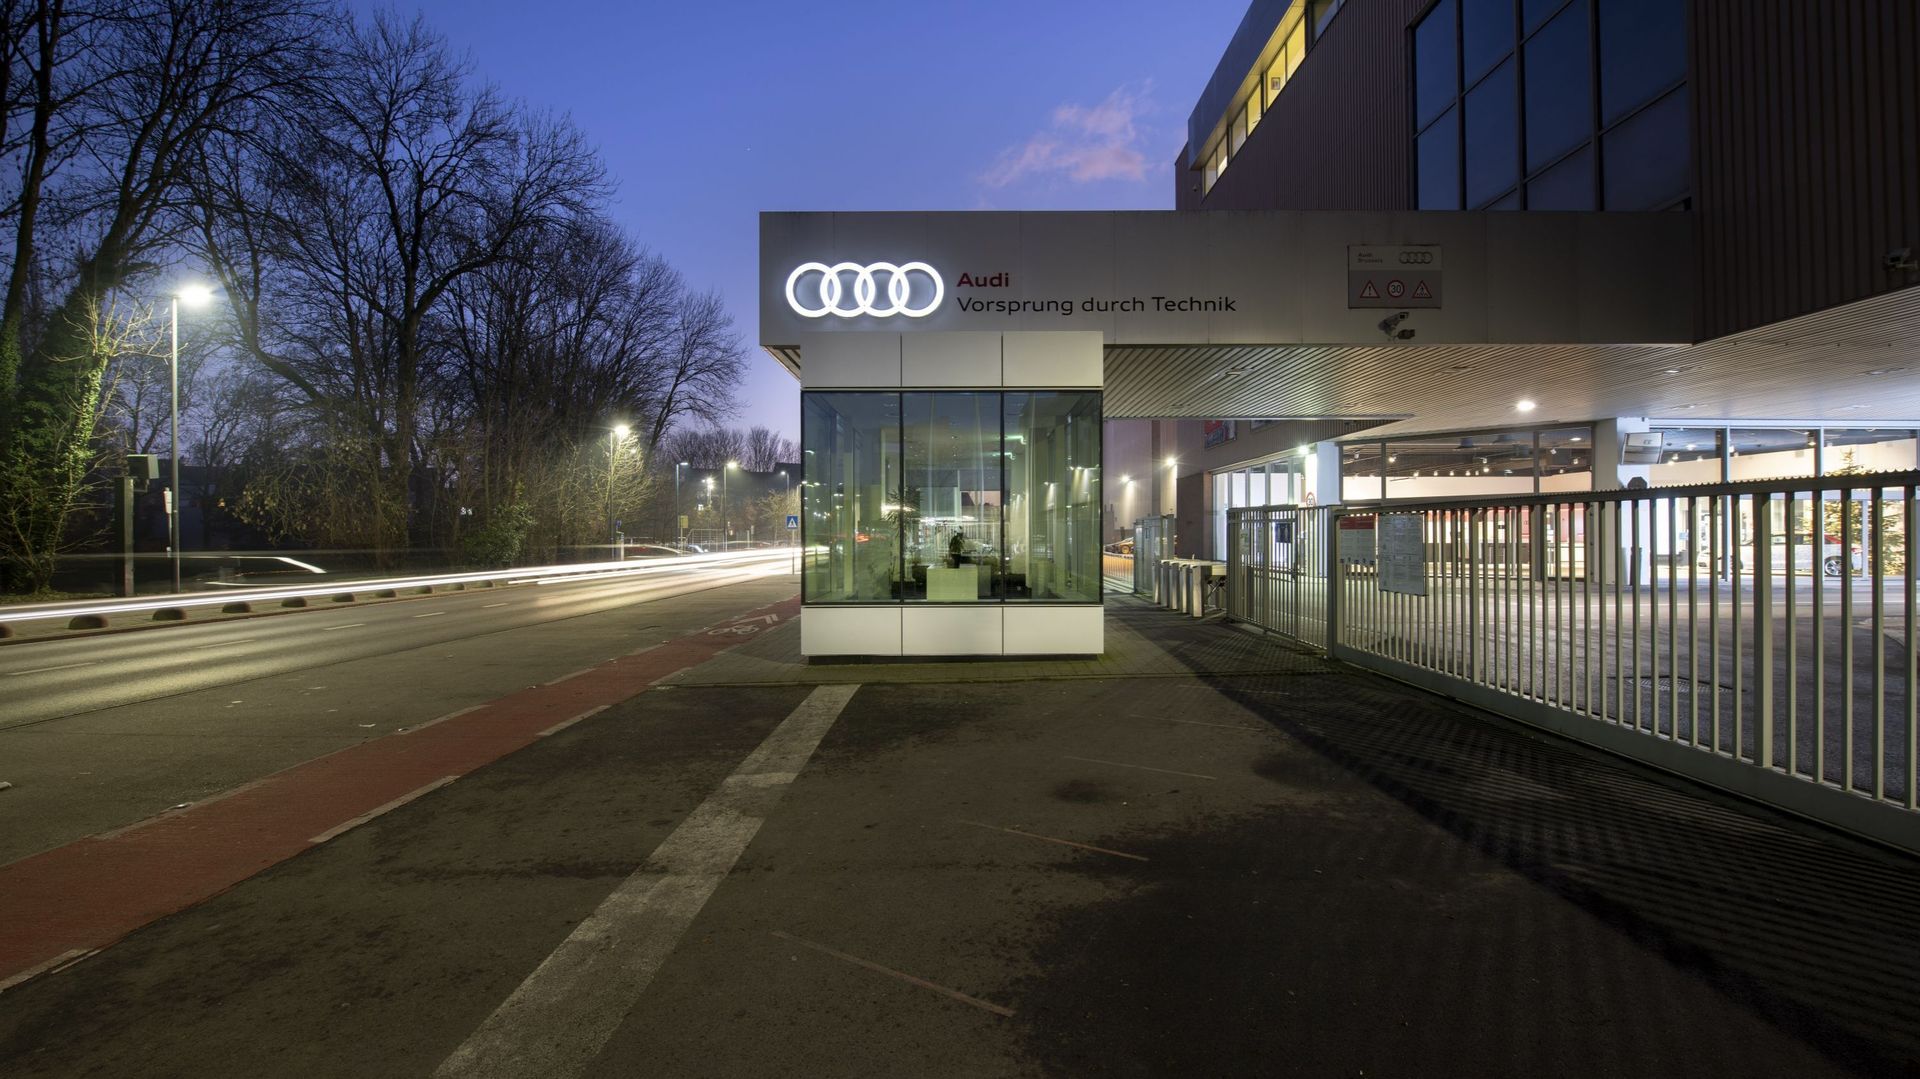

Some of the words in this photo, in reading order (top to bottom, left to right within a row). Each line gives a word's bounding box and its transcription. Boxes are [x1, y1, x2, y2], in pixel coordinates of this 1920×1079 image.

[956, 272, 1010, 288] Audi
[1391, 284, 1401, 293] 30
[956, 297, 1073, 315] Vorsprung
[1081, 296, 1144, 312] durch
[1152, 296, 1237, 312] Technik
